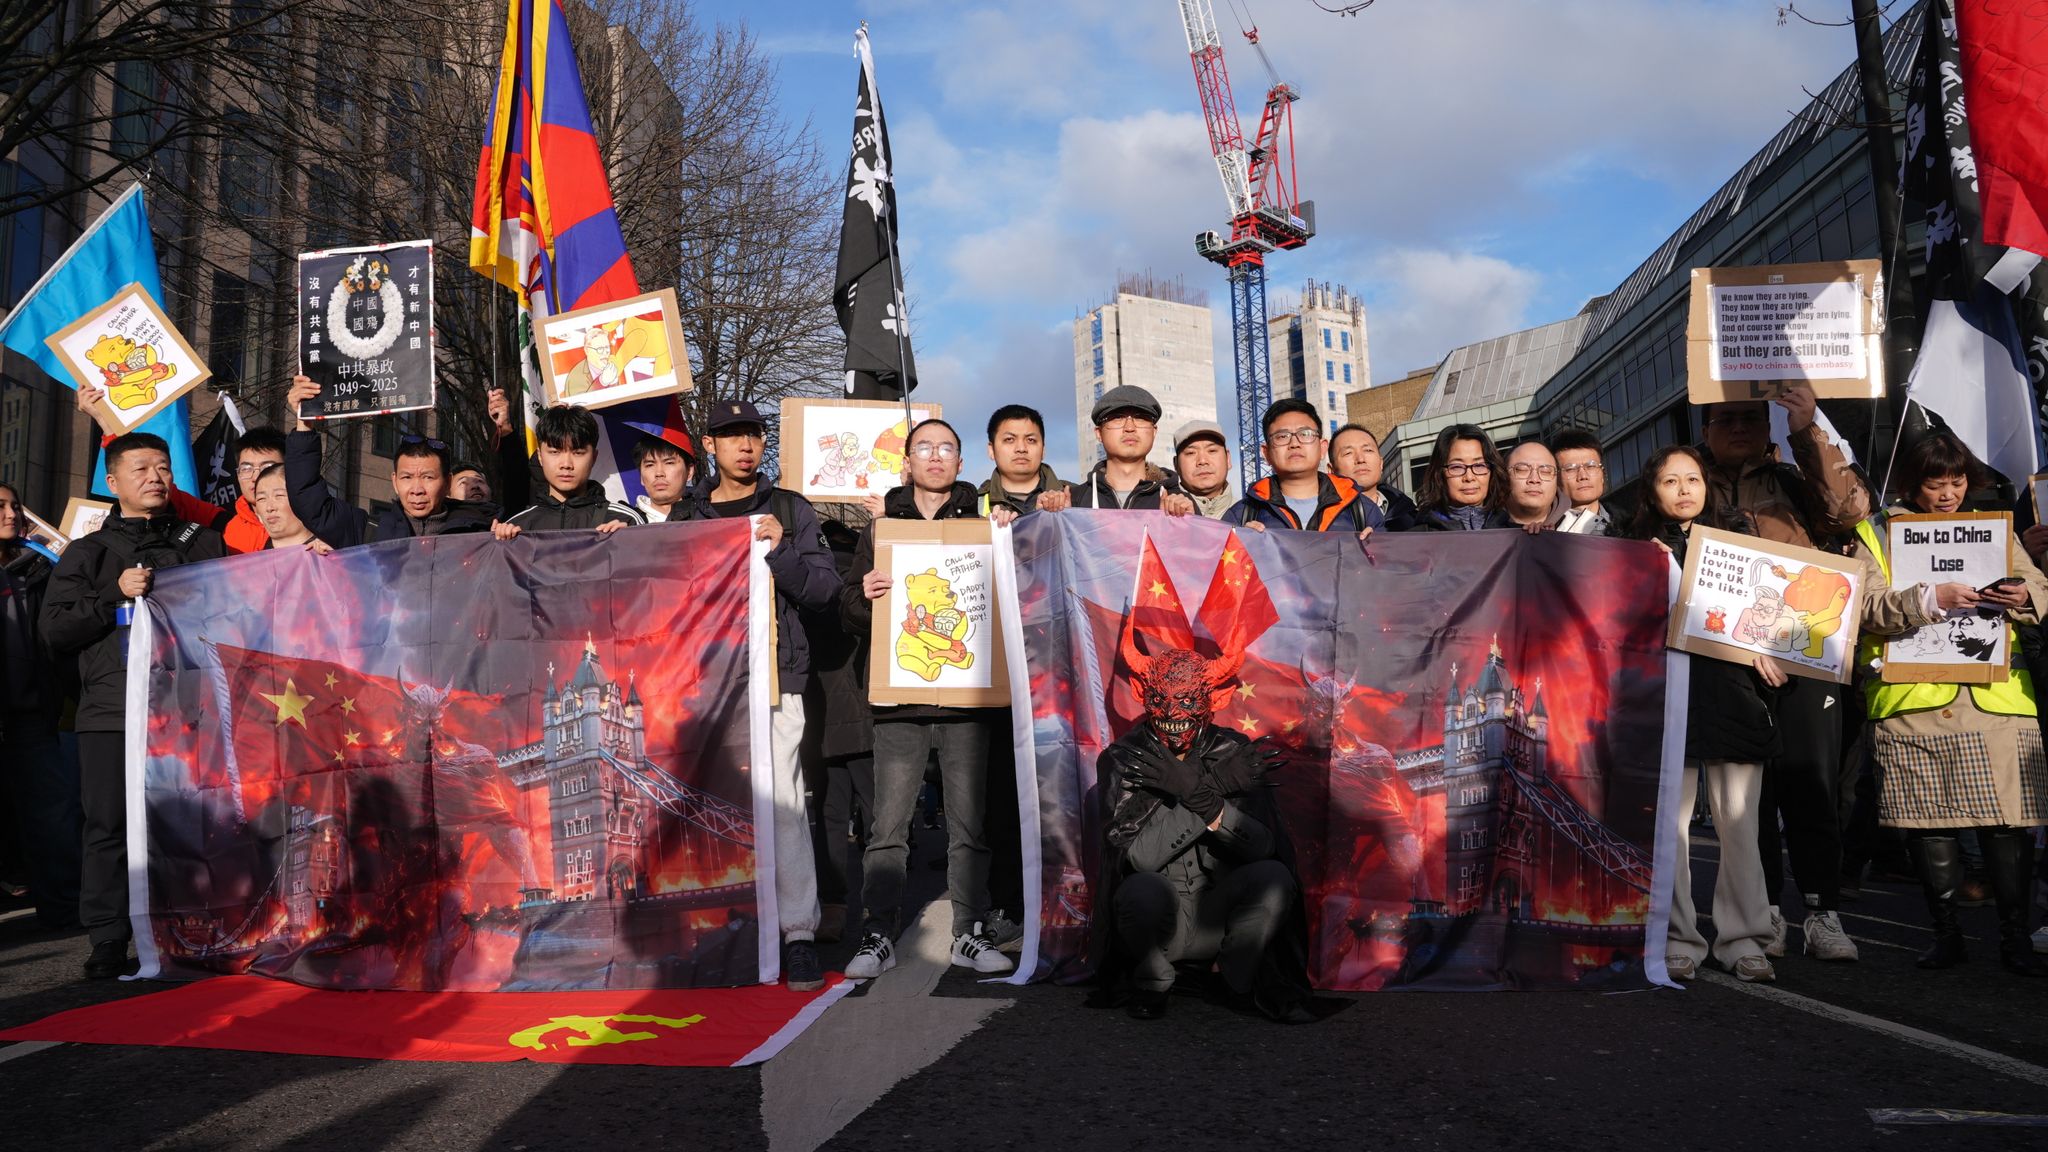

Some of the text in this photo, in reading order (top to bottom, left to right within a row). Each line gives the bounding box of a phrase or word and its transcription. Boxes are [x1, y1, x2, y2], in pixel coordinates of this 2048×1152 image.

[1721, 293, 1732, 302] We
[1734, 293, 1754, 301] know
[1756, 292, 1772, 301] they
[1788, 291, 1810, 301] lying.
[408, 265, 421, 350] 才有新中國
[1721, 301, 1816, 312] They know they are lying.
[107, 314, 121, 329] CALL
[115, 307, 139, 331] FATHER
[1721, 310, 1852, 322] They know we know they are lying.
[132, 317, 151, 337] DADDY
[1722, 323, 1736, 332] And
[1737, 323, 1745, 331] of
[1747, 323, 1773, 331] course
[1787, 322, 1808, 330] know
[145, 329, 160, 343] GOOD
[1722, 331, 1852, 343] they know we know they are lying.
[1722, 342, 1853, 359] But they are still lying.
[338, 358, 394, 379] 中共暴政
[1722, 360, 1853, 372] Say NO to china mega embassy
[178, 528, 194, 543] NIKE
[1904, 526, 1992, 545] Bow to China
[1705, 545, 1751, 564] Labour
[945, 557, 963, 568] CALL
[950, 560, 983, 576] FATHER
[1702, 555, 1745, 576] loving
[1931, 555, 1964, 572] Lose
[1700, 567, 1744, 585] the UK
[960, 582, 985, 597] DADDY
[1698, 577, 1749, 598] be like:
[963, 593, 986, 604] I'M A
[966, 603, 987, 614] GOOD
[969, 612, 988, 623] BOY!
